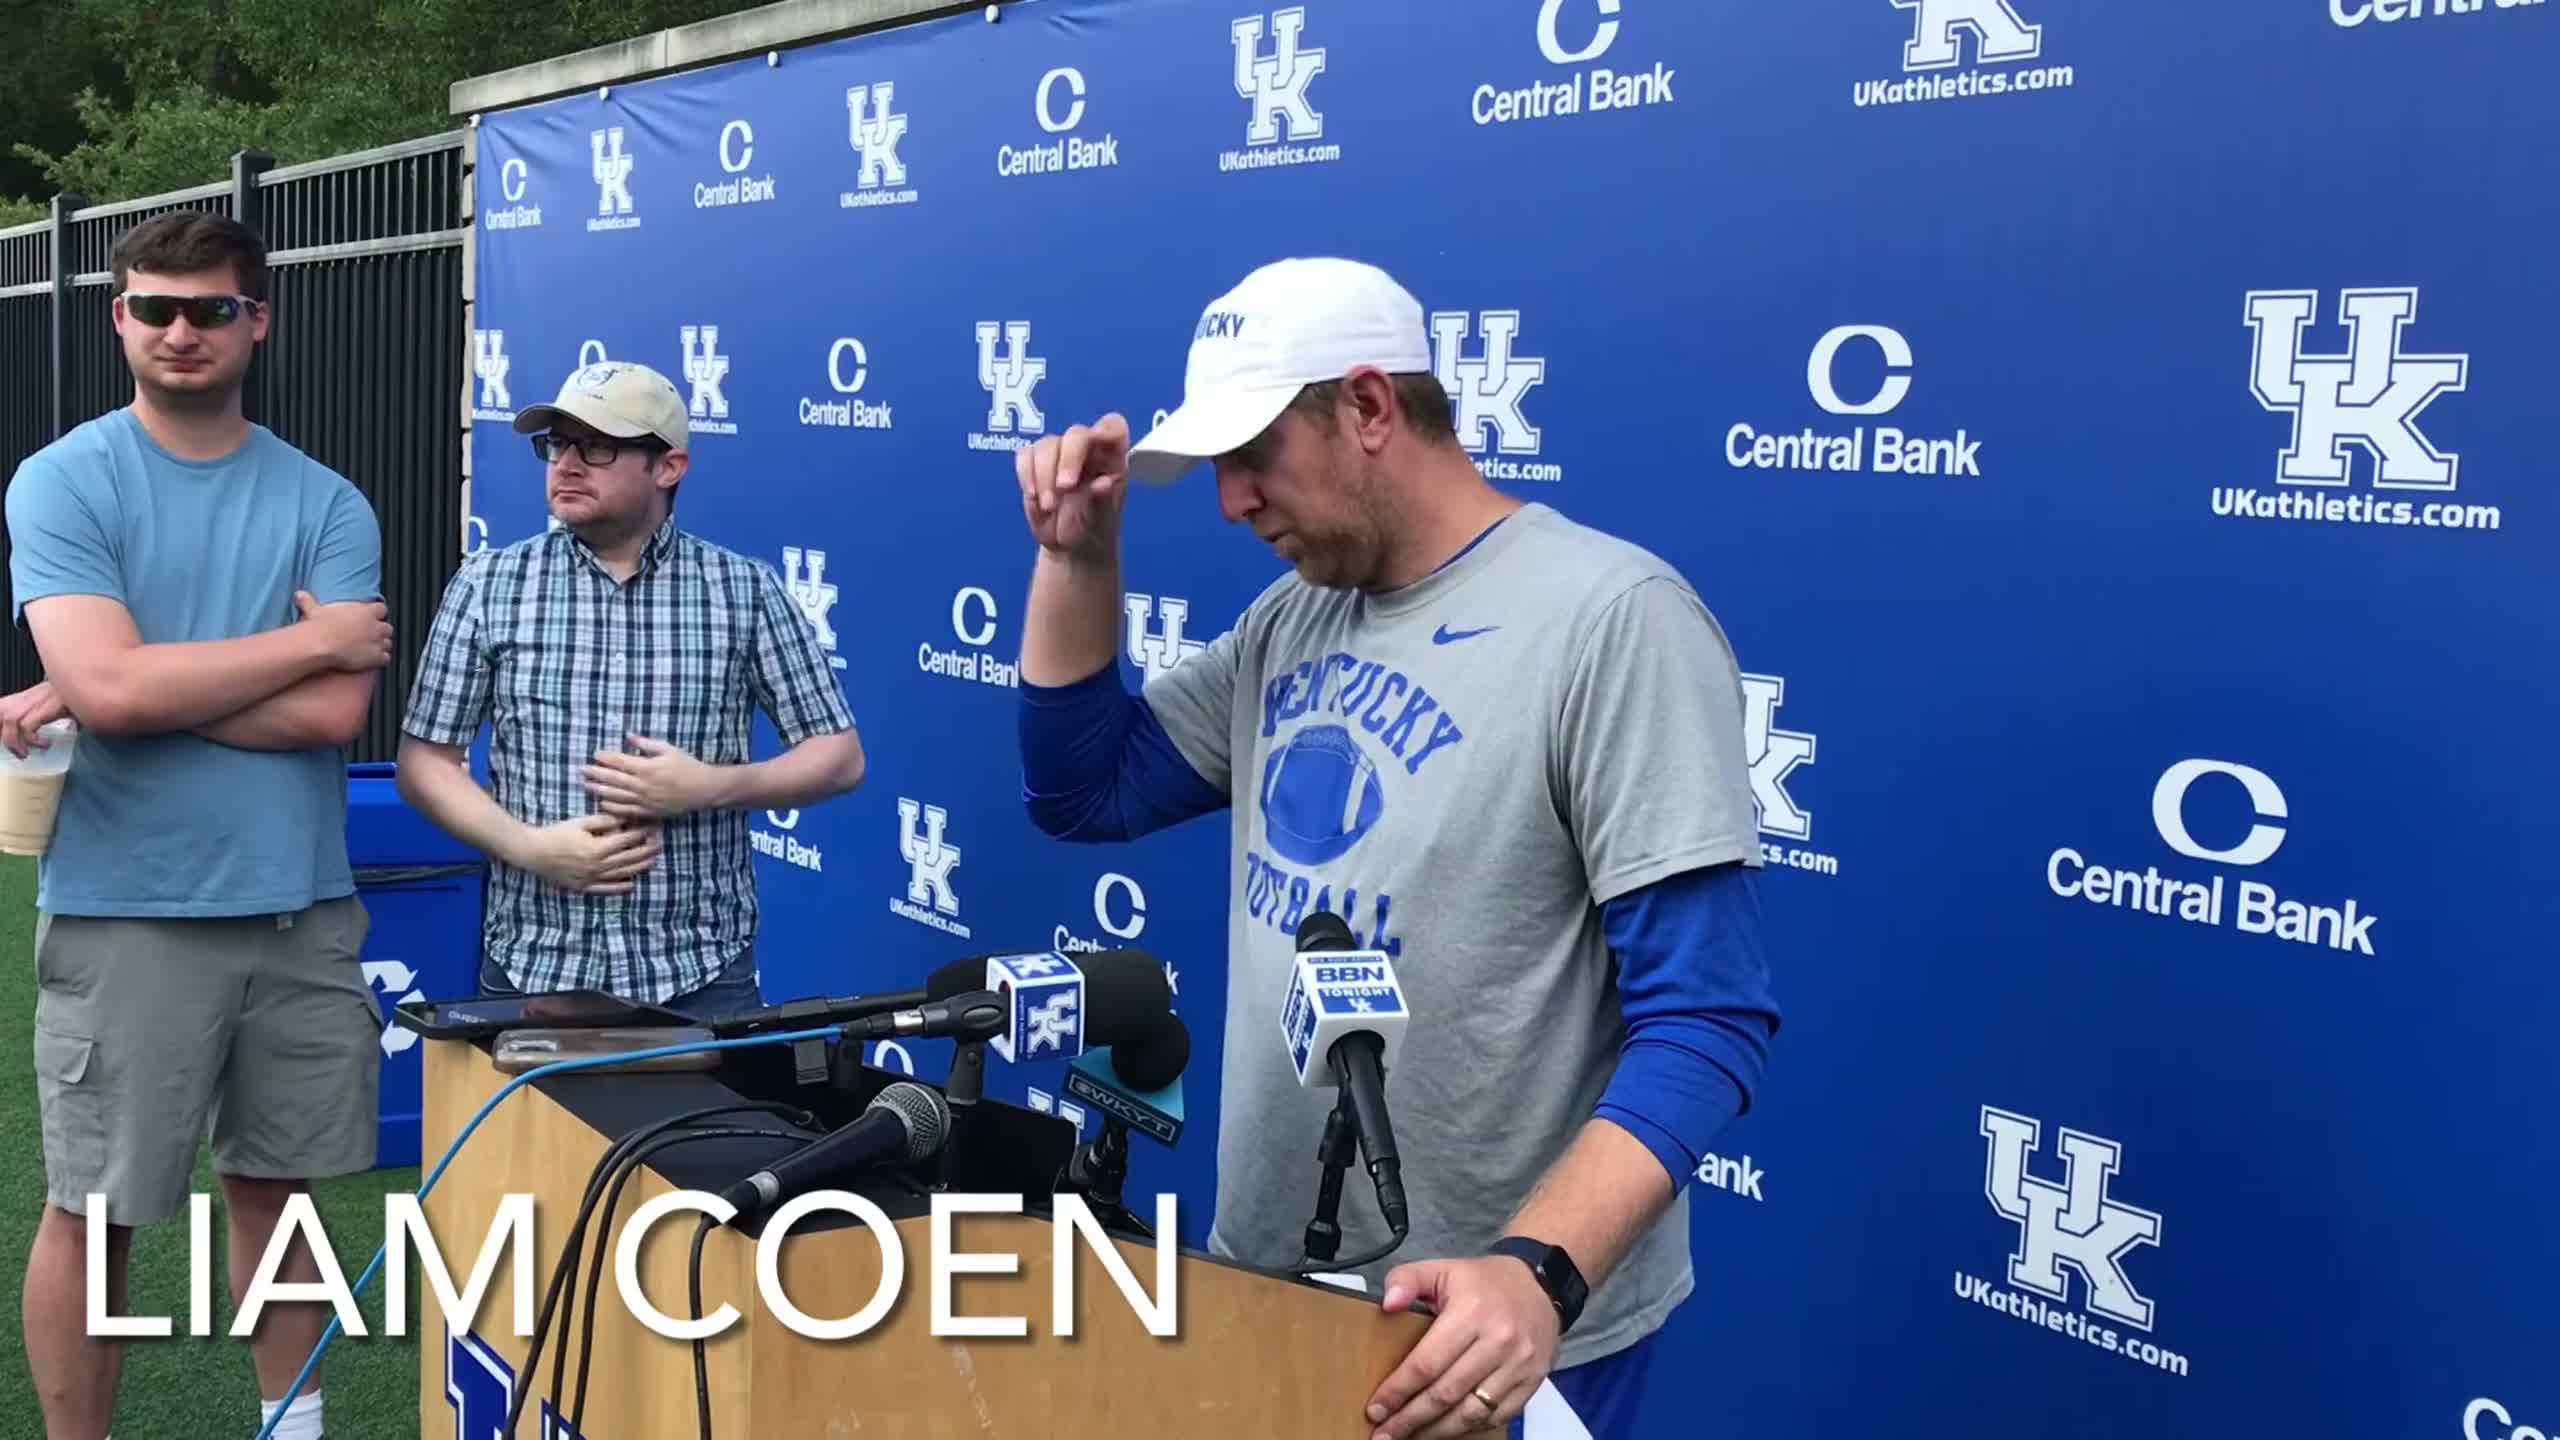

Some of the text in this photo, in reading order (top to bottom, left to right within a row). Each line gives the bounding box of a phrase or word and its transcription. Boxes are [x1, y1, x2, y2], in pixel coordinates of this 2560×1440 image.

[1232, 5, 1326, 146] UK
[1472, 62, 1676, 125] Central Bank
[1853, 65, 2073, 107] UKathletics.com
[846, 80, 908, 190] UK
[998, 134, 1119, 177] Central Bank
[1219, 144, 1341, 172] UKathletics.com
[694, 174, 776, 209] Central Bank
[840, 188, 919, 209] UKathletics.com
[976, 320, 1047, 434] UK
[2243, 286, 2469, 491] UK
[799, 397, 892, 429] Central Bank
[1724, 423, 1982, 478] Central Bank
[2211, 486, 2501, 531] UKathletics.com
[918, 642, 978, 680] Central
[750, 830, 822, 873] entral Bank
[898, 796, 961, 916] UK
[890, 897, 971, 940] UKathletics.com
[2046, 848, 2379, 956] Central Bank
[1315, 966, 1385, 983] BBN
[1322, 986, 1392, 998] TONIGHT
[1698, 1151, 1765, 1202] ank
[1980, 1104, 2163, 1332] UK
[1954, 1271, 2189, 1377] UKathletics.com
